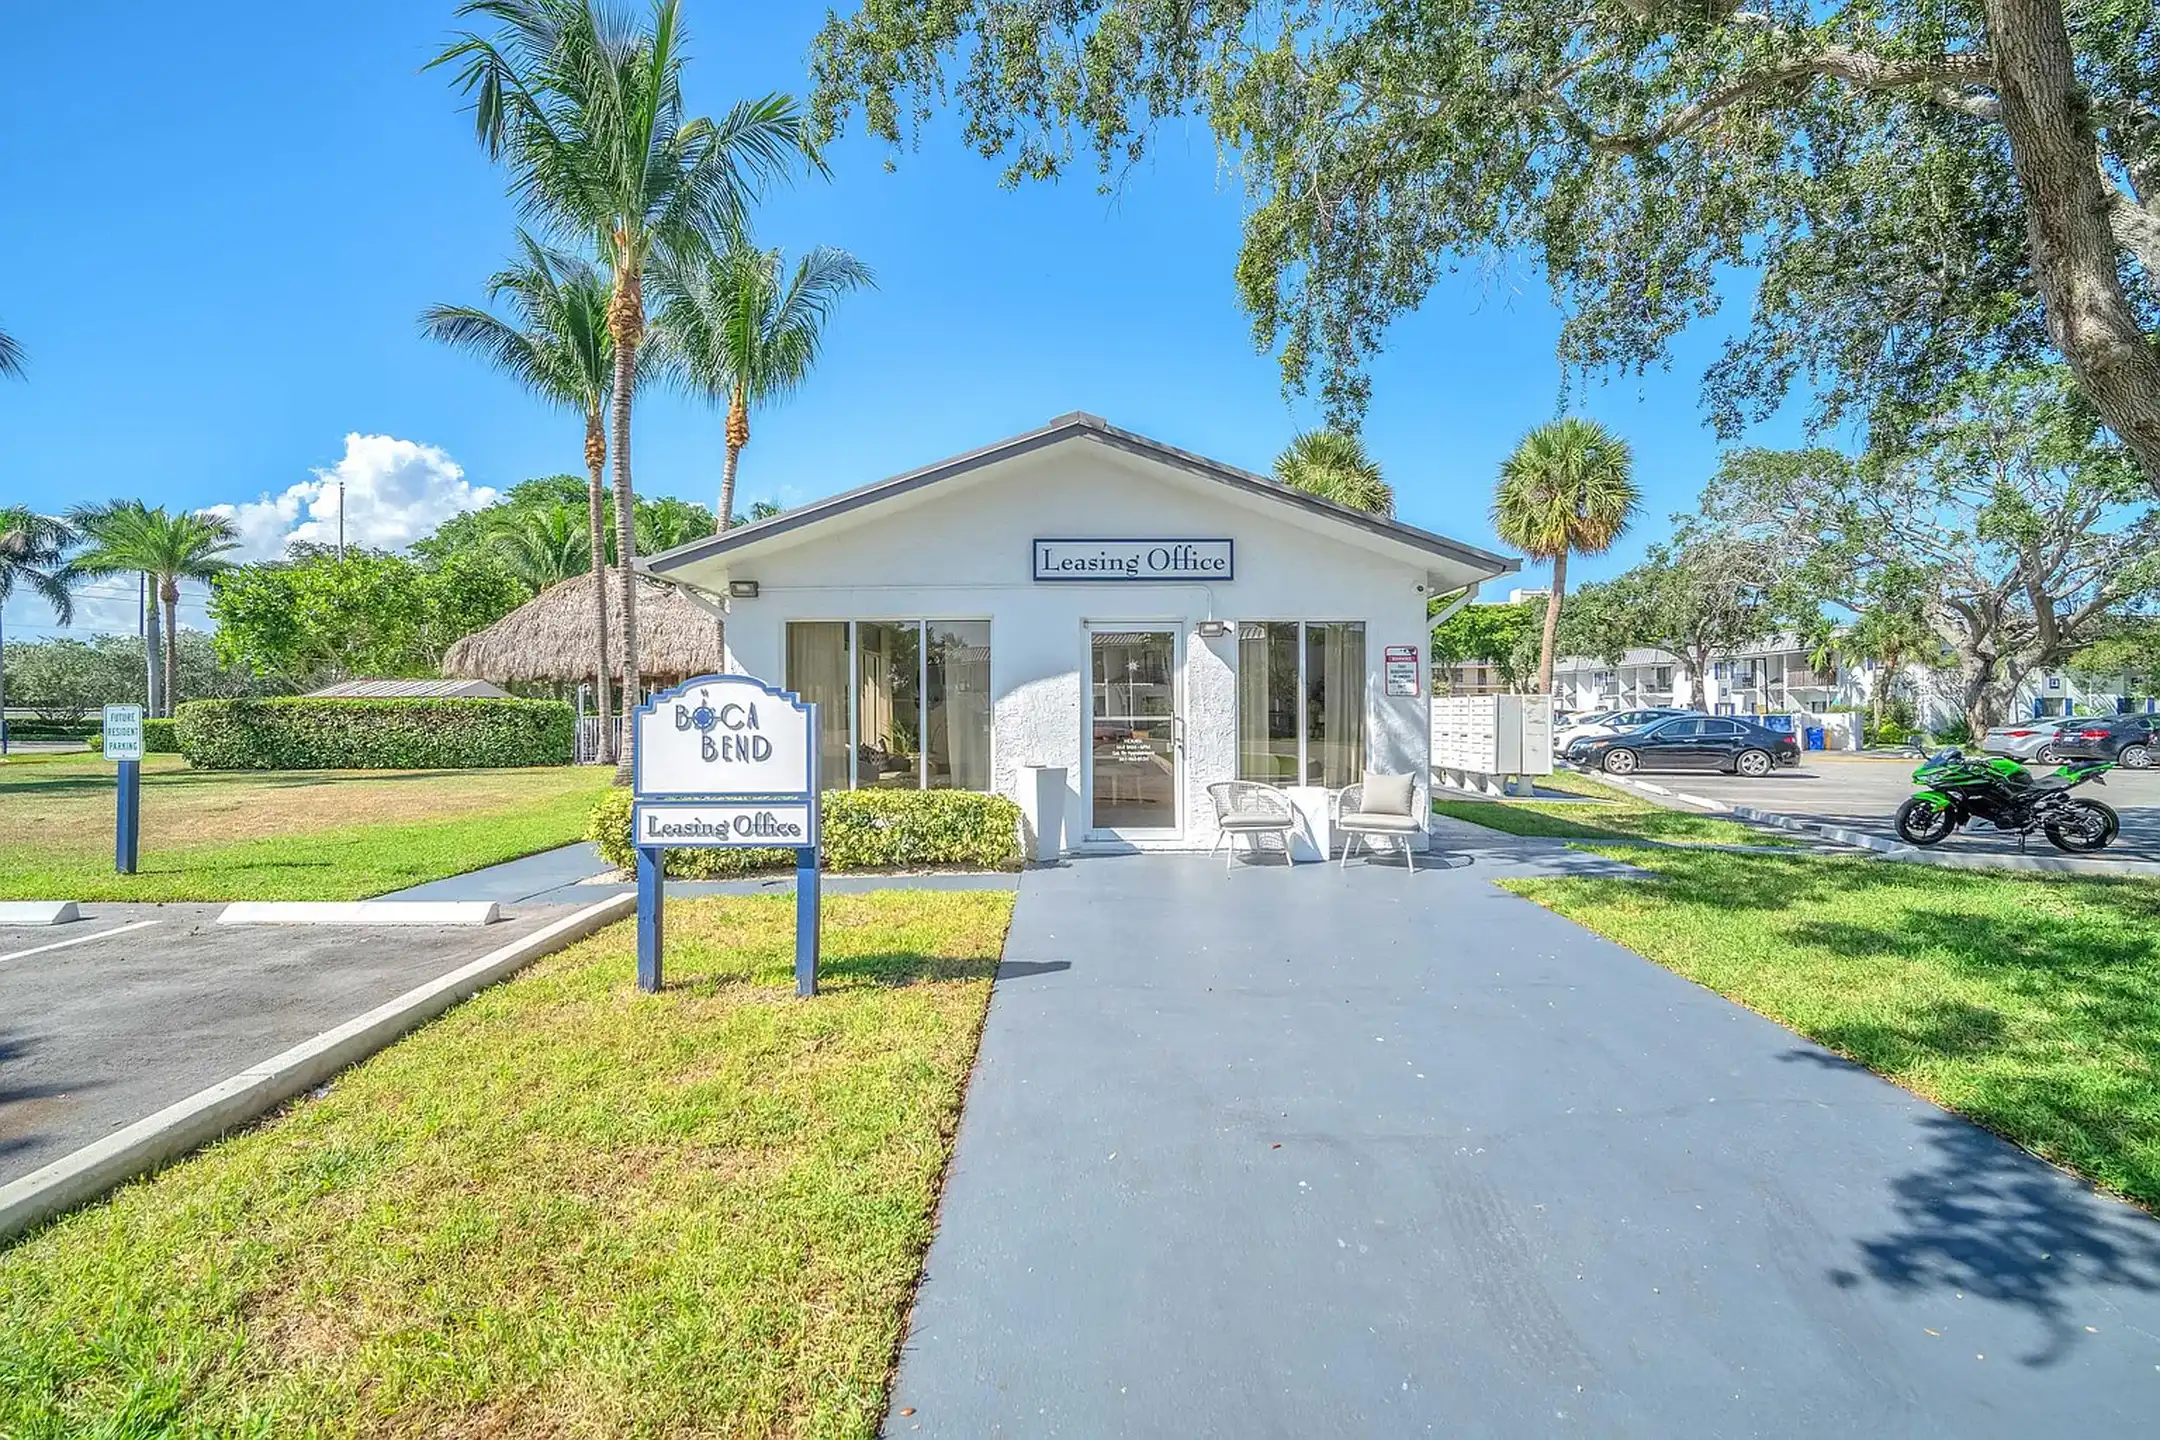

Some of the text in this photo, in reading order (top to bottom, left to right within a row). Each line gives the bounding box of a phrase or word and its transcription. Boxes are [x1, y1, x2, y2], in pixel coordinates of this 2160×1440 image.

[1042, 544, 1226, 576] Leasing Office
[110, 712, 136, 722] FUTURE
[675, 701, 760, 732] BOCA
[108, 727, 138, 737] RESIDENT
[109, 741, 138, 751] PARKING
[701, 734, 773, 764] BEND
[647, 812, 801, 841] Leasing Office
